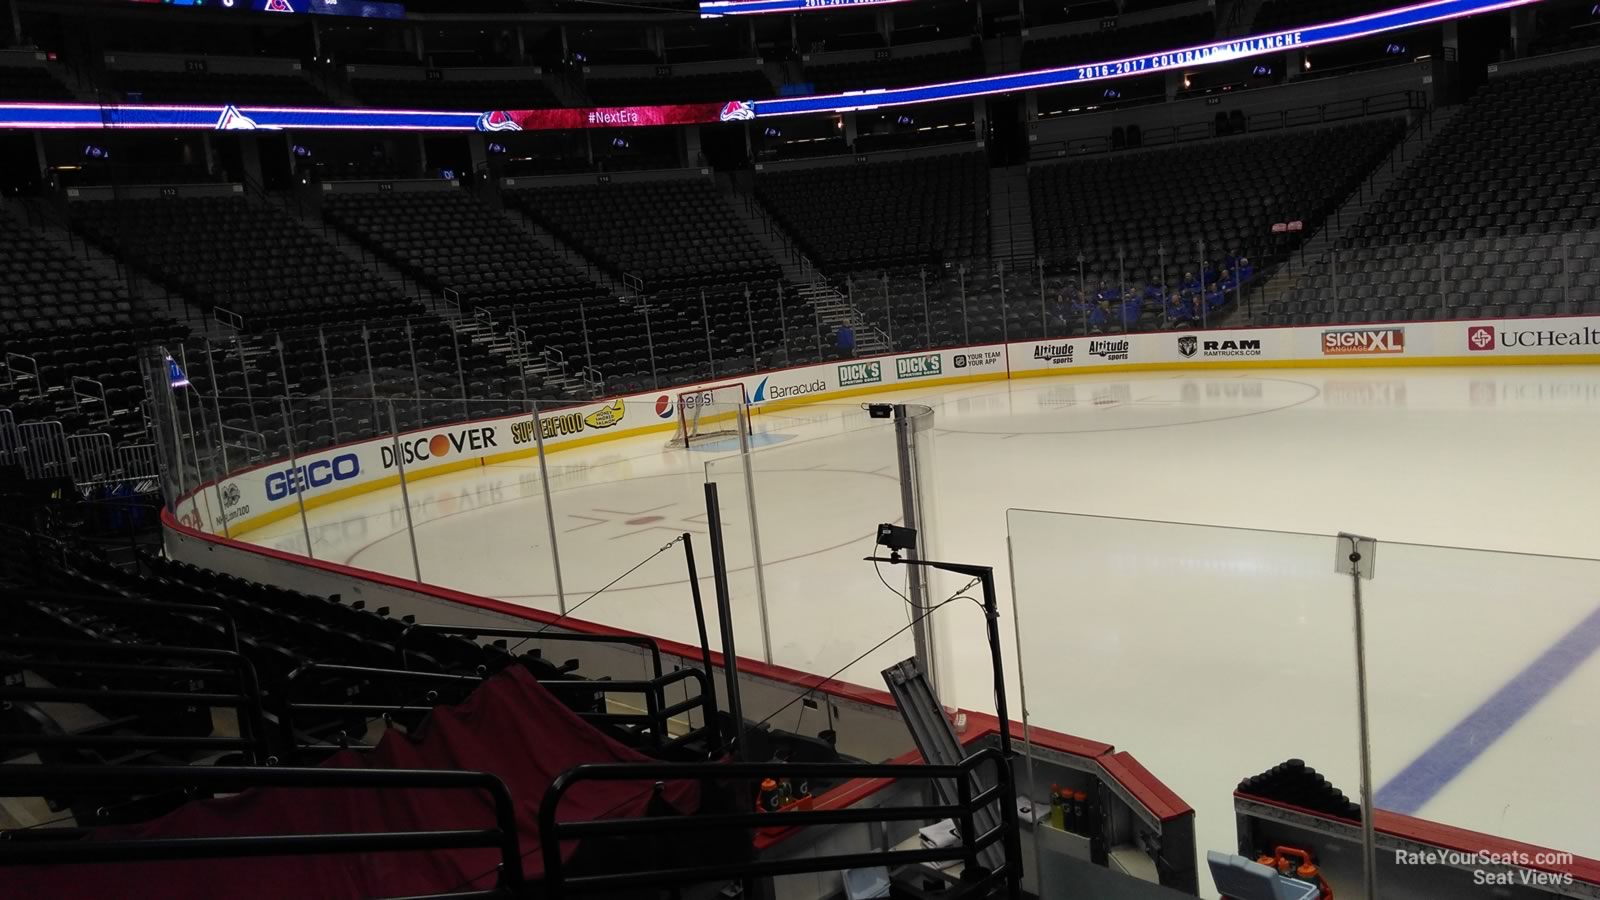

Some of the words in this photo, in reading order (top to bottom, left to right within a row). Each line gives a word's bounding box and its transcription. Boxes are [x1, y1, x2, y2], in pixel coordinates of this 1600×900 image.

[1079, 60, 1145, 79] 2016-2017
[1152, 46, 1219, 68] COLORADO
[1223, 33, 1301, 55] AVALANCHE
[588, 110, 638, 124] #NextEra
[1034, 343, 1074, 357] Altitude
[1089, 340, 1129, 353] Altitude
[1203, 339, 1260, 350] RAM
[1326, 345, 1368, 353] LANGUAGE
[984, 351, 1001, 359] TEAM
[1053, 356, 1073, 364] sports
[1108, 353, 1129, 361] sports
[840, 363, 879, 381] DICK'S
[898, 356, 939, 374] DICK'S
[770, 379, 826, 399] Barracuda
[511, 412, 584, 444] SUPERFOOD
[380, 427, 498, 469] DISCOVER
[265, 453, 360, 501] GEICO
